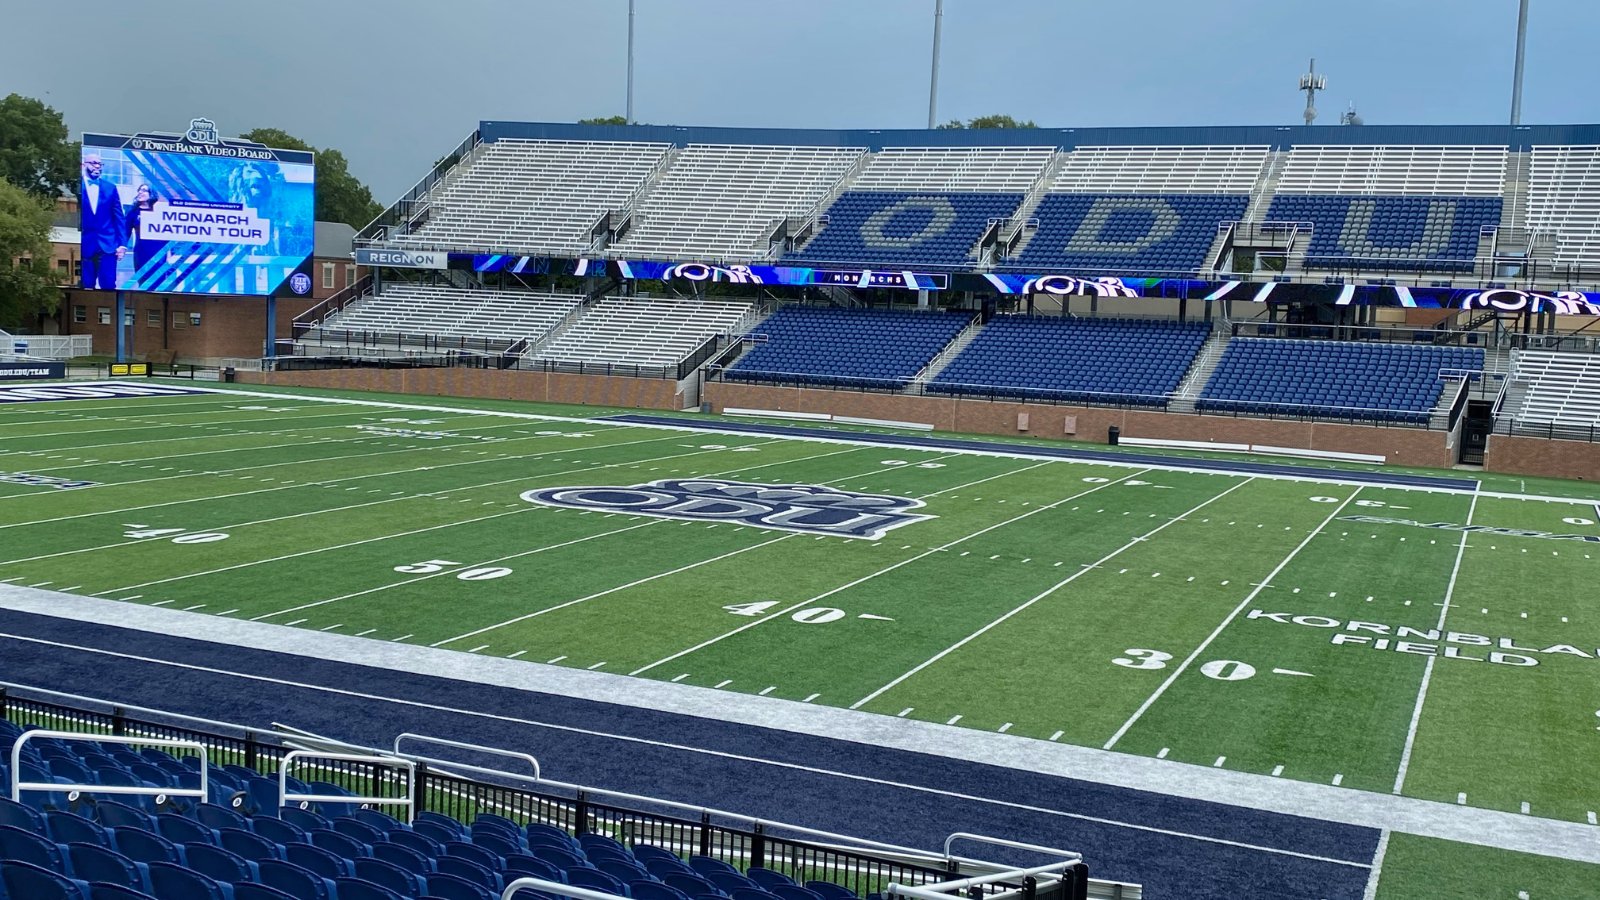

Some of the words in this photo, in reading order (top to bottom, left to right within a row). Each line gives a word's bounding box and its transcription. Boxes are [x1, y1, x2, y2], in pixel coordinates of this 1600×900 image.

[188, 130, 217, 143] ODU
[204, 145, 236, 157] VIDEO
[238, 147, 272, 160] BOARD
[162, 211, 249, 226] MONARCH
[148, 223, 212, 236] NATION
[217, 227, 262, 239] TOUR
[369, 252, 411, 264] REIGN
[415, 255, 434, 265] ON
[1246, 608, 1600, 660] KORNBLA
[1331, 633, 1540, 667] FIELD
